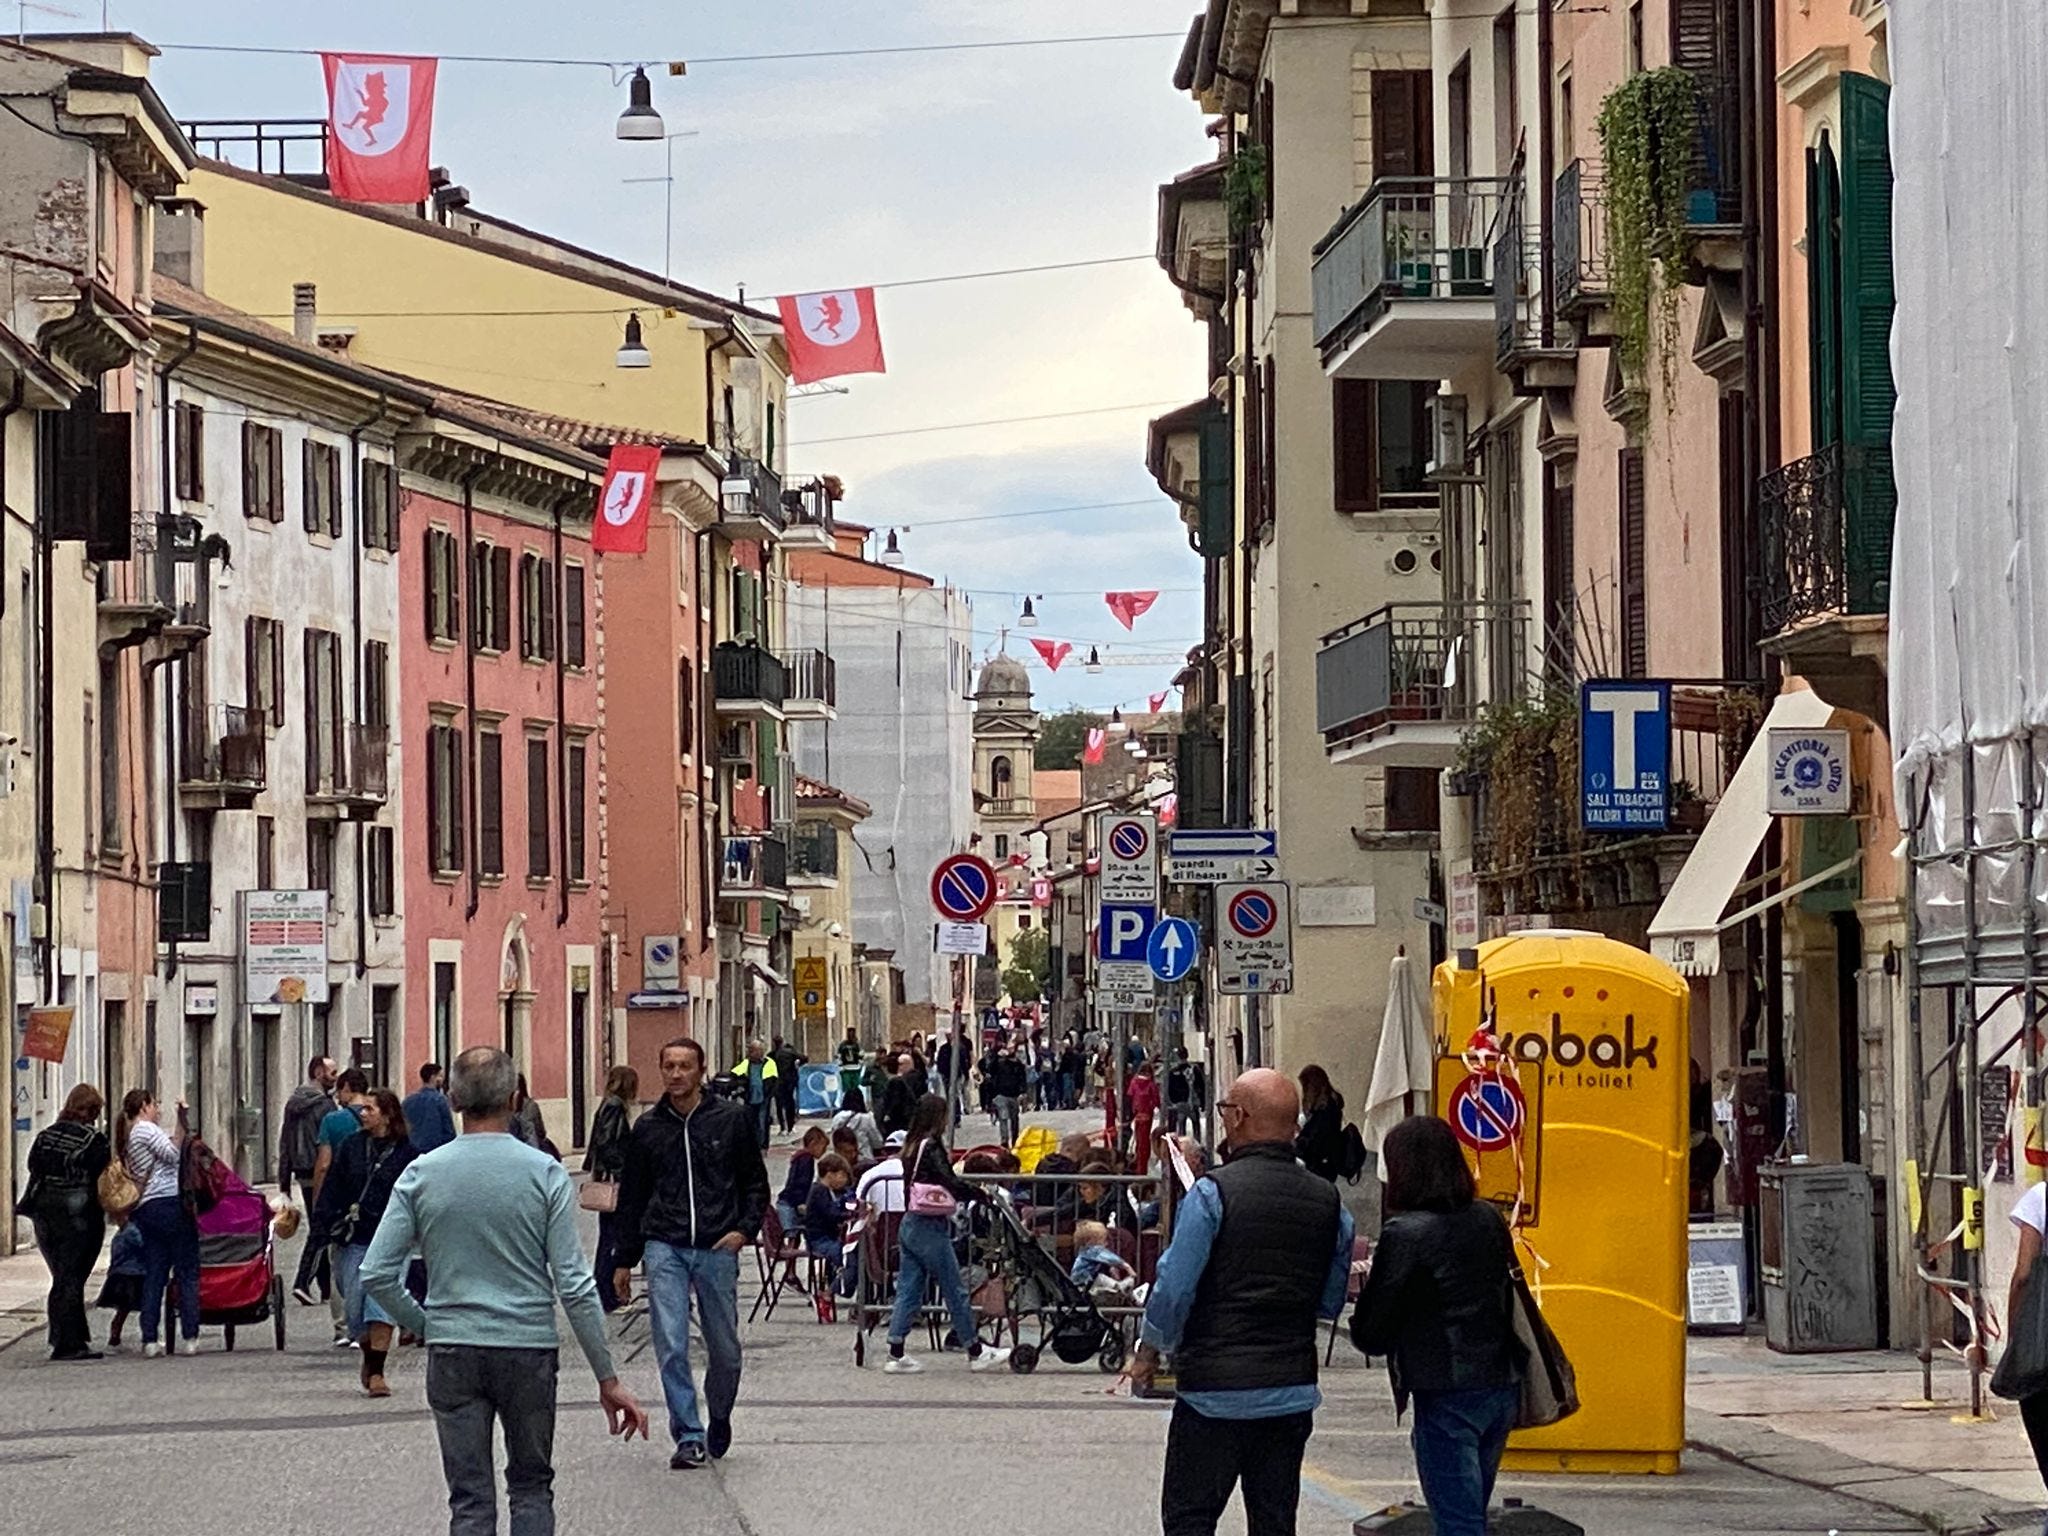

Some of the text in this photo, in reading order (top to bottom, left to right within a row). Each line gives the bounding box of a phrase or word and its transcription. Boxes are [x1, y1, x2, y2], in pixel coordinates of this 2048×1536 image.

[1590, 691, 1659, 789] T
[1774, 739, 1842, 793] RICEVITORIA LOTTO
[1587, 793, 1663, 807] SALI TABACCHI
[1586, 808, 1664, 823] VALORI BOLLATI
[1172, 860, 1215, 869] guardia
[1172, 871, 1228, 880] di finanza
[1111, 911, 1144, 955] P
[1577, 1072, 1633, 1089] toilet
